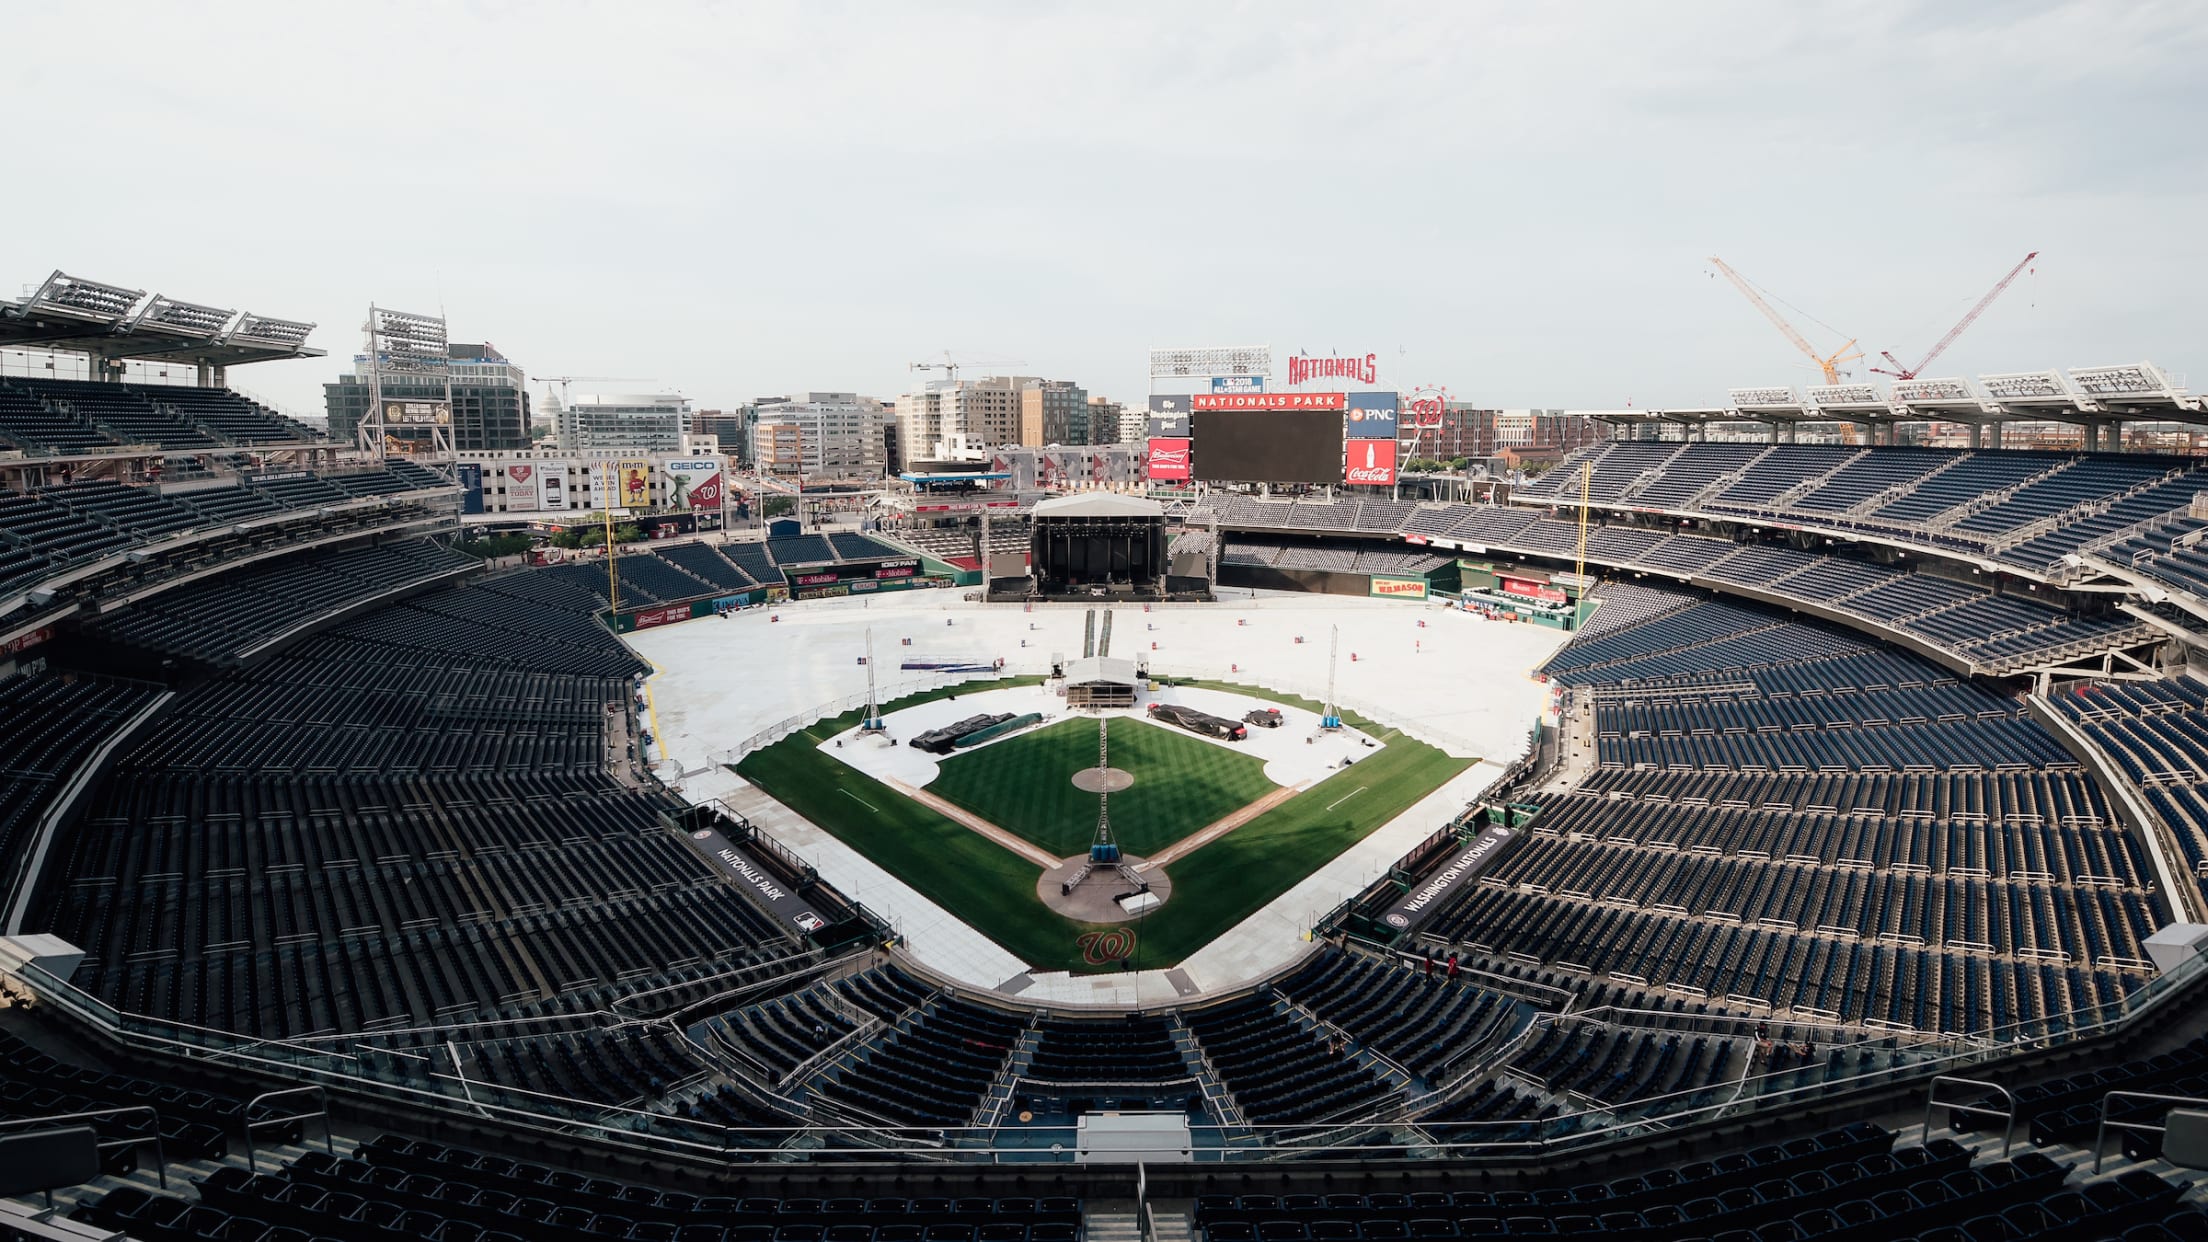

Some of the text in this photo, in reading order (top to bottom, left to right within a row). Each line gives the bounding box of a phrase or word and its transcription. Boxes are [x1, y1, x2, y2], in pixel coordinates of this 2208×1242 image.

[1289, 353, 1376, 385] NATIONALS
[1199, 396, 1335, 406] NATIONALS PARK
[1366, 409, 1394, 421] PNC
[670, 462, 715, 470] GEICO
[717, 849, 785, 901] NATIONALS PARK
[1404, 836, 1498, 913] WASHINGTON NATIONALS
